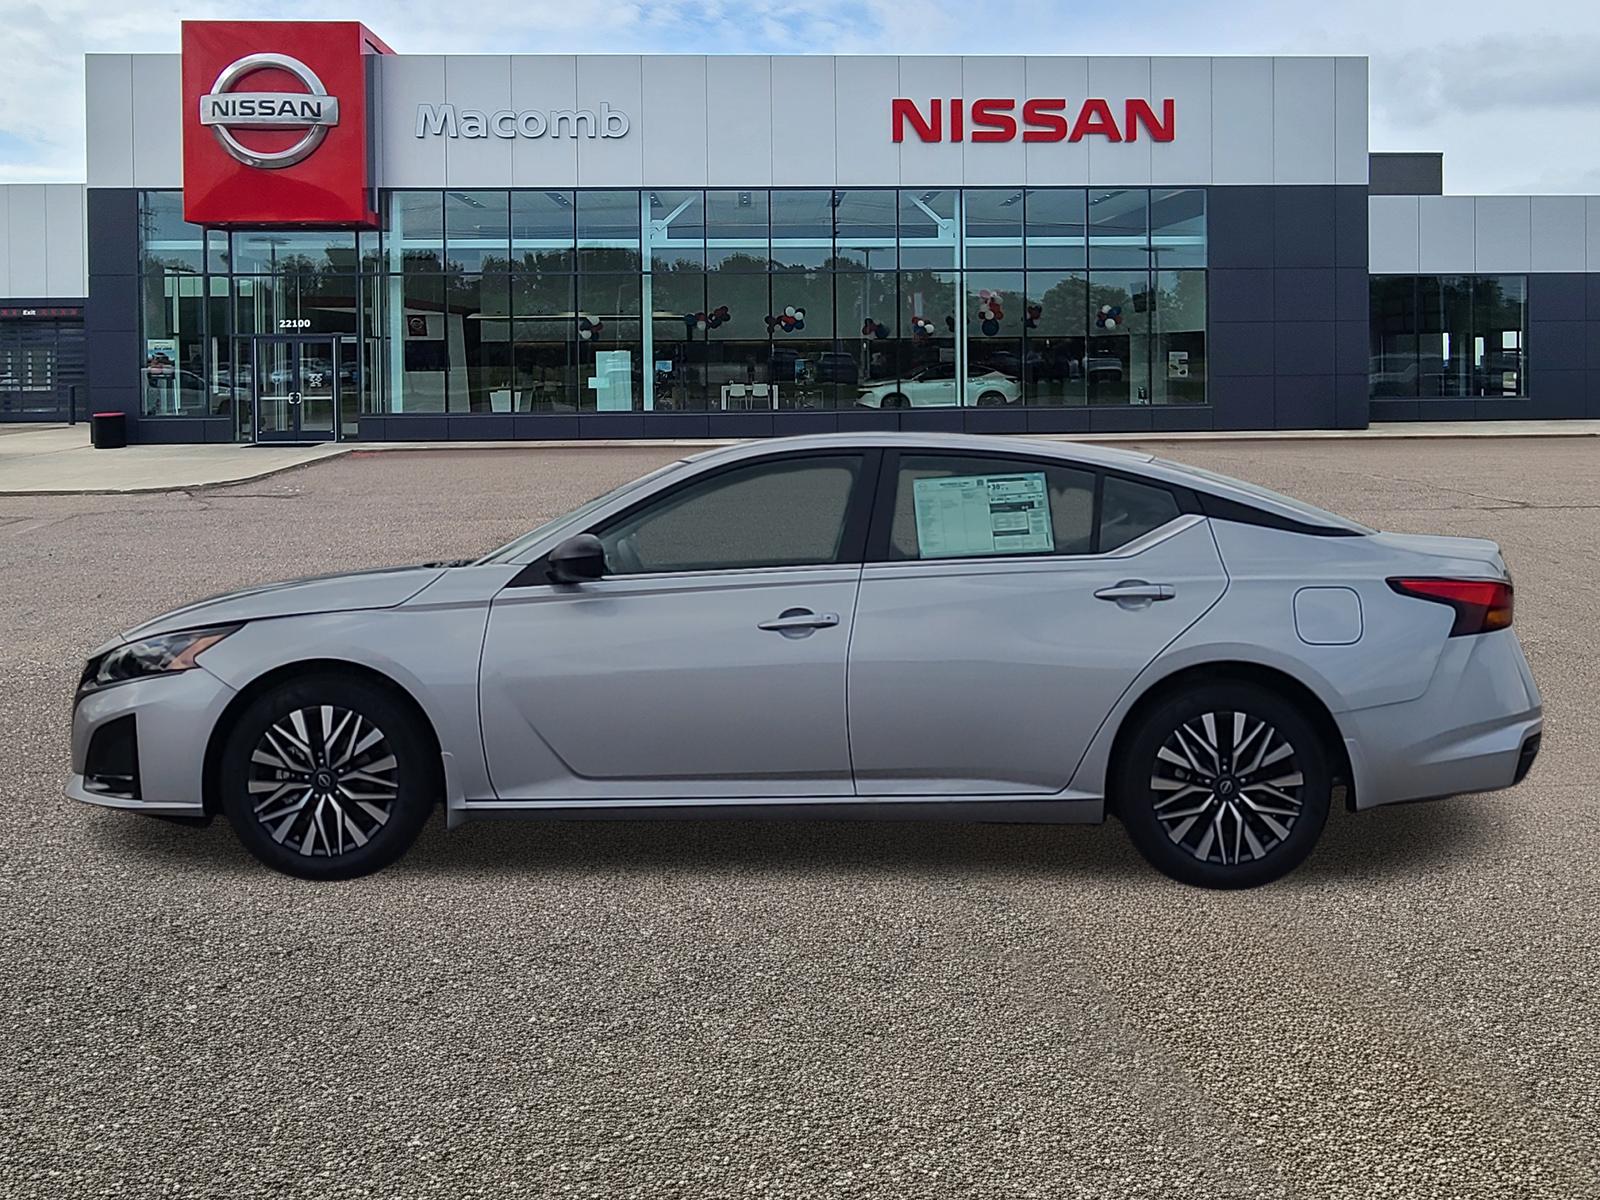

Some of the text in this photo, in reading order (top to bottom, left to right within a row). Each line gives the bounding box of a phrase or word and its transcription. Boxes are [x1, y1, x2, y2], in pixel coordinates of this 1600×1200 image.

[212, 100, 322, 118] NISSAN
[415, 102, 630, 139] Macomb
[892, 98, 1176, 143] NISSAN
[279, 319, 311, 328] 22100
